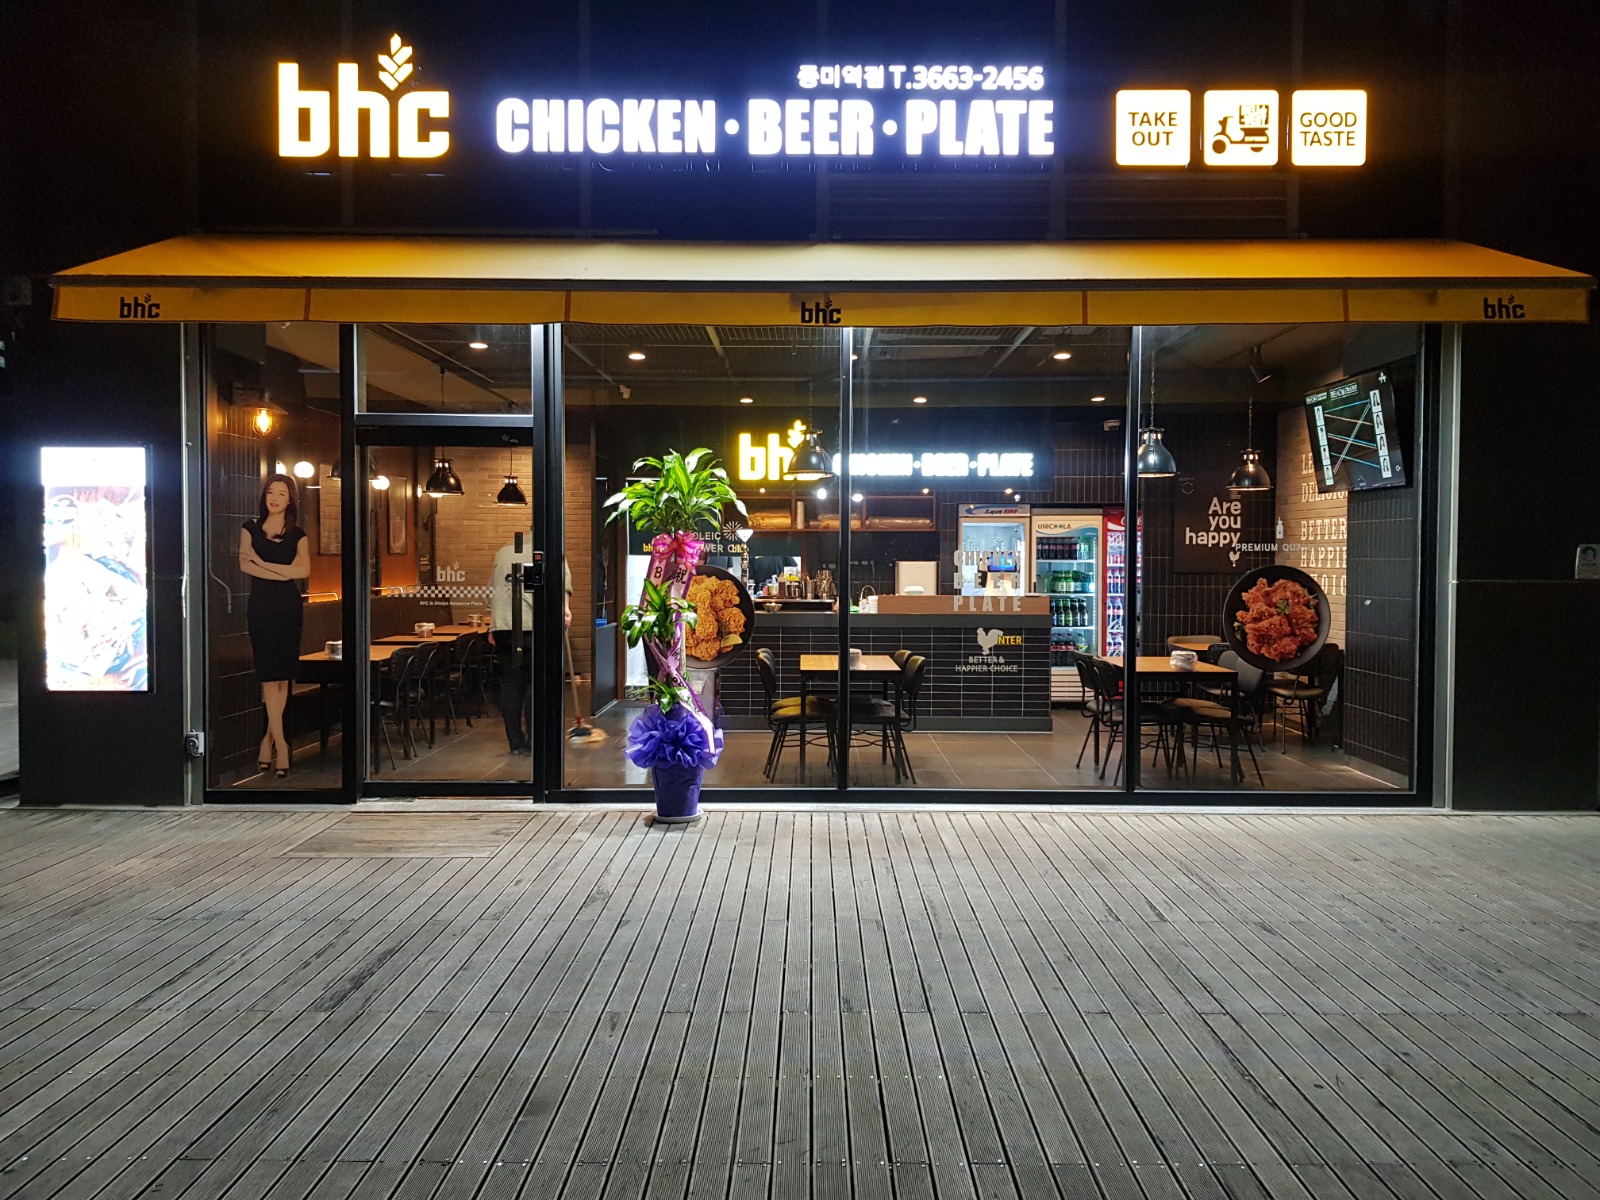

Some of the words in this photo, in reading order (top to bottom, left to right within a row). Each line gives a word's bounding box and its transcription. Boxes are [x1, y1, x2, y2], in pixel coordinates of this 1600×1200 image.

[889, 65, 1045, 91] T.3663-2456
[278, 61, 450, 159] bhc
[1128, 111, 1178, 127] TAKE
[495, 98, 717, 155] CHICKEN
[747, 98, 875, 156] BEER
[905, 98, 1055, 156] PLATE
[1299, 111, 1357, 128] GOOD
[1131, 131, 1174, 147] OUT
[1300, 131, 1356, 147] TASTE
[119, 296, 161, 319] bhc
[800, 301, 842, 324] bhc
[1483, 297, 1526, 319] bhc
[1208, 496, 1242, 515] Are
[1208, 515, 1242, 531] you
[1300, 517, 1348, 541] BETTER
[1185, 527, 1241, 547] happy
[1235, 543, 1279, 552] PREMIUM
[953, 549, 1022, 567] CHICKEN
[1300, 546, 1348, 569] HAPPIE
[436, 565, 466, 582] bhc
[953, 572, 1021, 590] BEER
[953, 595, 1022, 612] PLATE
[955, 665, 988, 673] HAPPIER
[989, 665, 1018, 673] CHOICE
[968, 656, 998, 664] BETTER
[998, 656, 1005, 664] &
